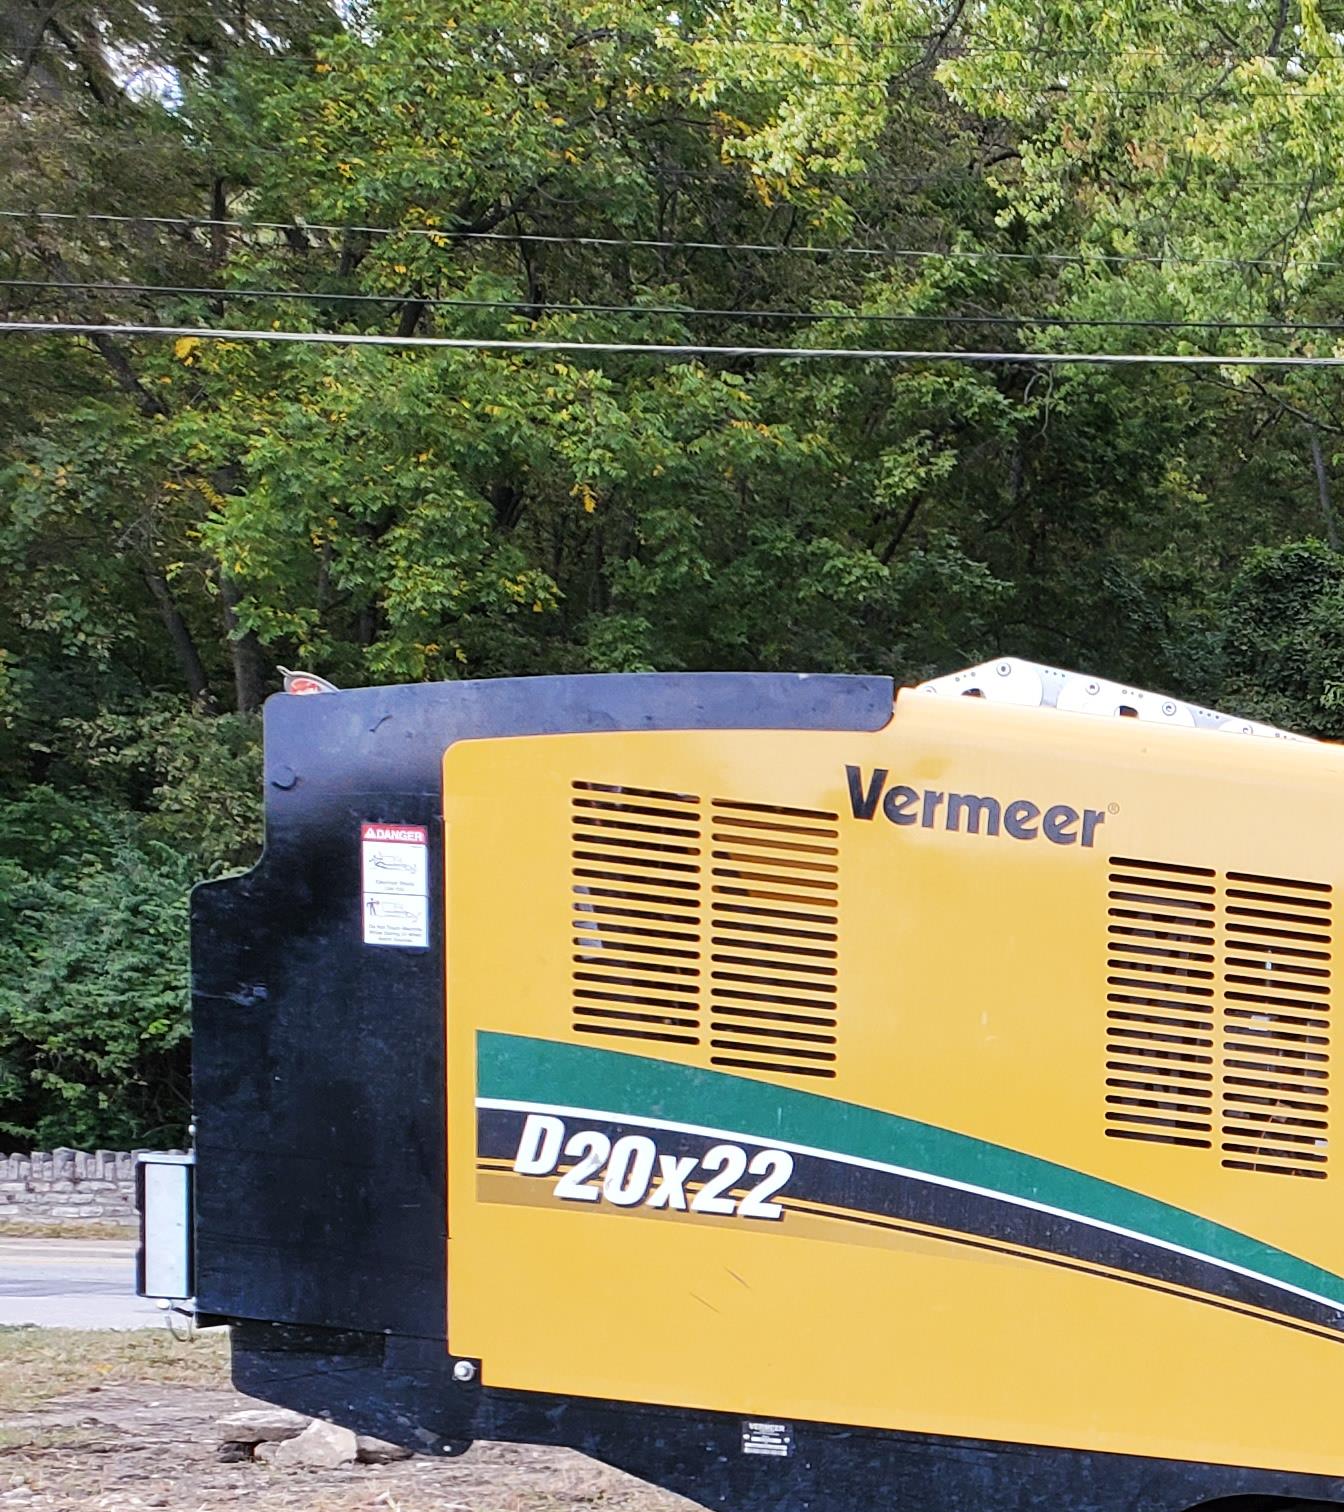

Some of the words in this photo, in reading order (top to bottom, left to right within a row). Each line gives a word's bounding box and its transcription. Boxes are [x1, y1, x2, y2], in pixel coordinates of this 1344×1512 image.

[376, 829, 422, 842] DANGER
[845, 764, 1106, 848] Vermeer
[513, 1113, 795, 1221] D20x22
